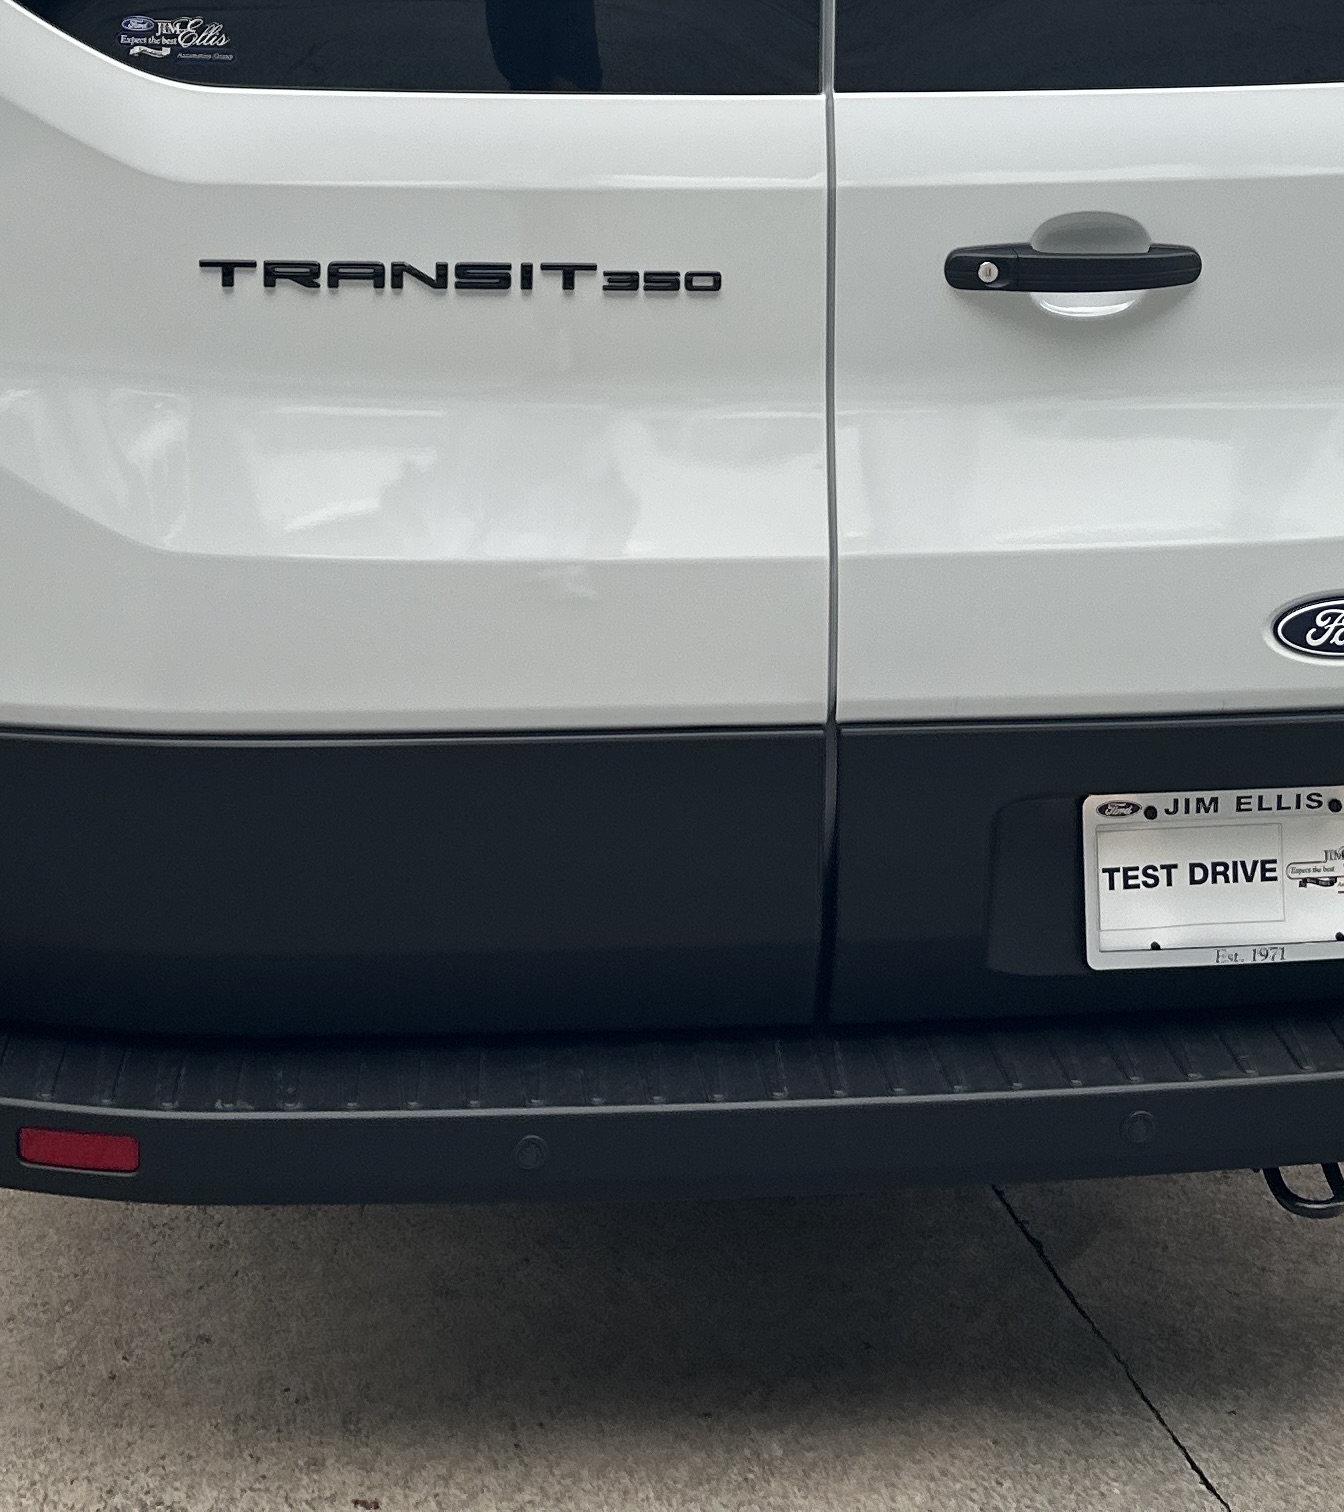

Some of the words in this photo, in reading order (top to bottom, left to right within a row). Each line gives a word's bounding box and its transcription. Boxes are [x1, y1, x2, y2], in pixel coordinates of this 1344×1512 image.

[120, 35, 147, 45] Expect
[148, 36, 161, 44] the
[162, 36, 177, 45] best
[156, 22, 181, 36] JIM
[176, 17, 230, 48] Ellis
[199, 259, 598, 290] TRANSIT
[601, 270, 722, 292] 350
[1164, 796, 1219, 816] JIM
[1235, 792, 1324, 813] ELLIS
[1102, 863, 1178, 890] TEST
[1188, 858, 1278, 886] DRIVE
[1215, 949, 1245, 964] Est.
[1252, 947, 1286, 962] 1971
